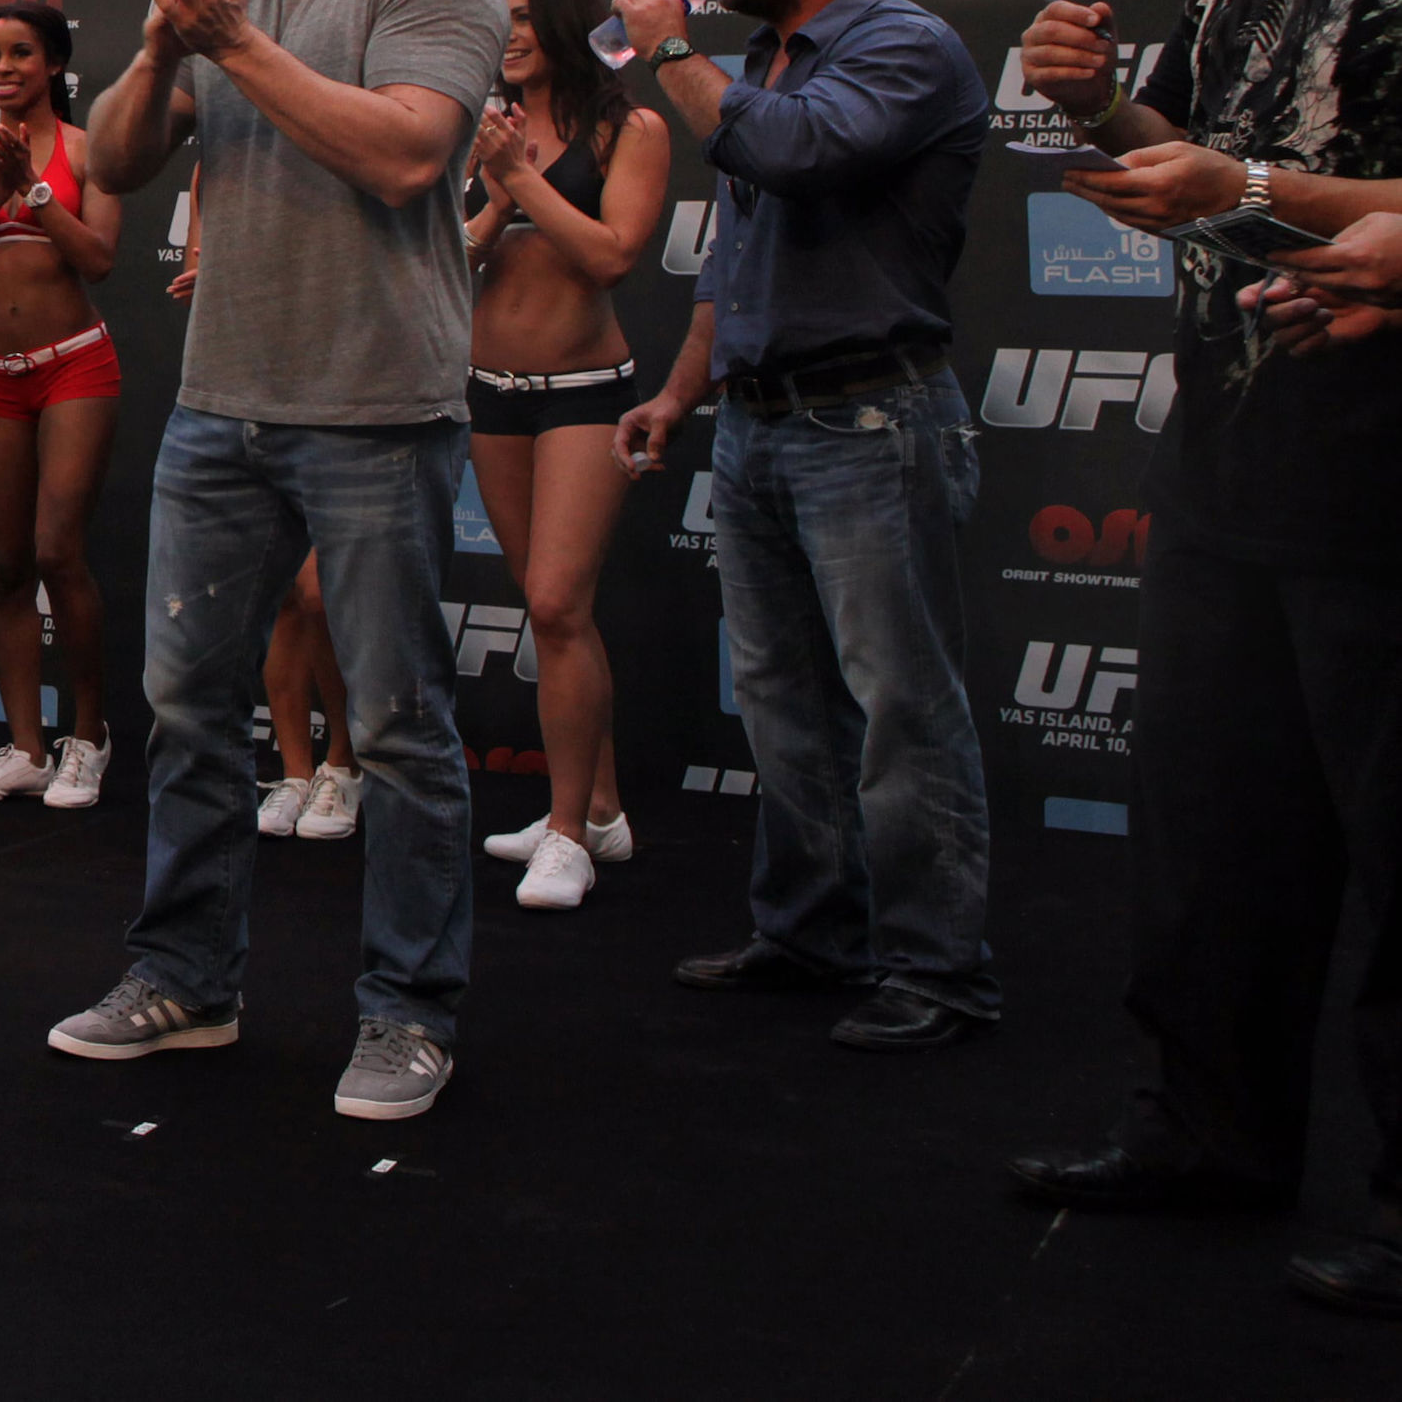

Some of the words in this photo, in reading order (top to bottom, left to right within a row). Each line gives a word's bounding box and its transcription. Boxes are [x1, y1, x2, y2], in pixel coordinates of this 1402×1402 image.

[1019, 114, 1072, 129] ISLA
[157, 249, 183, 262] YAS
[1044, 266, 1161, 284] FLASH
[669, 534, 700, 549] YAS
[1002, 569, 1050, 582] ORBIT
[1053, 571, 1141, 588] SHOWTIME
[1014, 641, 1139, 714] UF
[999, 707, 1034, 725] YAS
[1039, 710, 1116, 735] ISLAND,
[1042, 730, 1100, 751] APRIL
[1105, 736, 1131, 757] 10,
